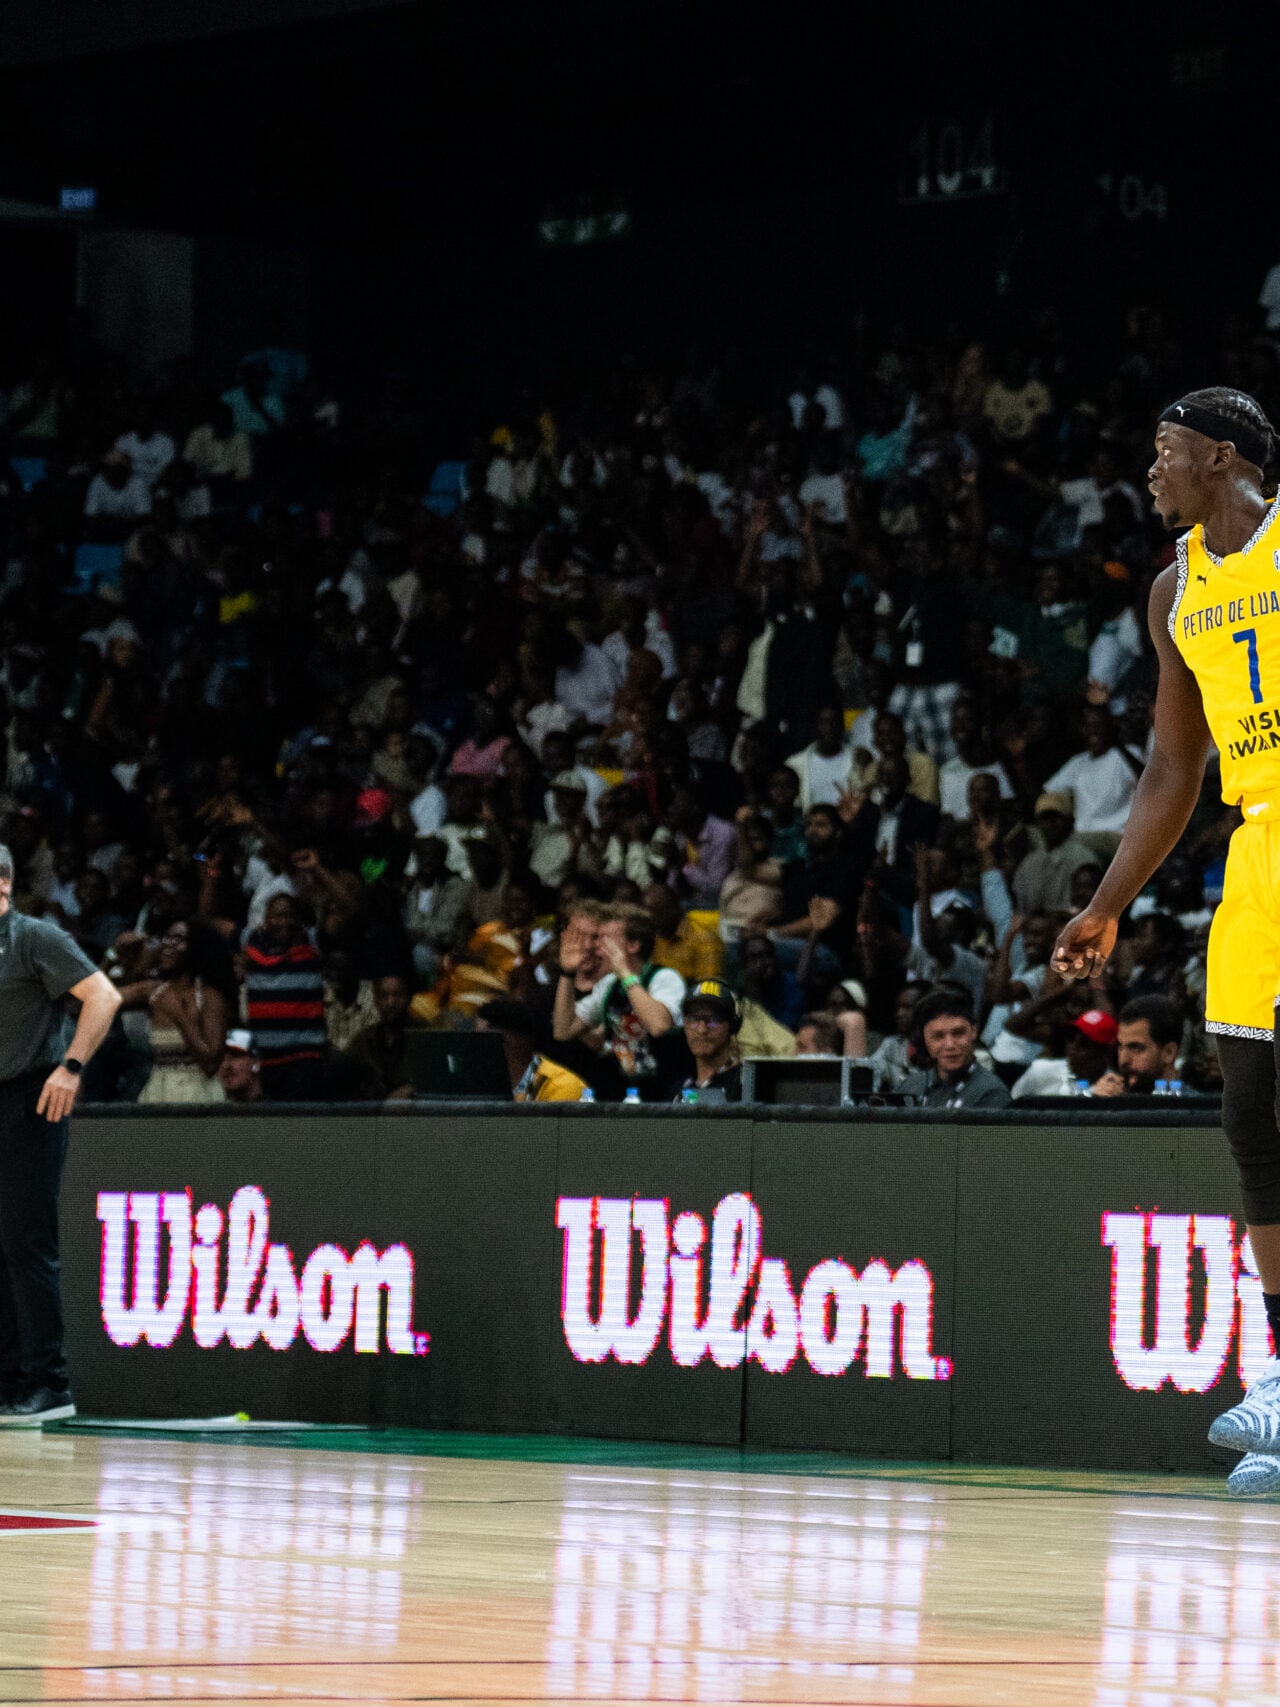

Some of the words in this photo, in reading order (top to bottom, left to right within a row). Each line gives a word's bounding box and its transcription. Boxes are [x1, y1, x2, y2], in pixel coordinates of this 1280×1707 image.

[1183, 602, 1223, 640] PETRO
[1229, 598, 1245, 624] DE
[1232, 628, 1264, 704] 7
[97, 1185, 415, 1354] Wilson
[555, 1191, 936, 1380] Wilson
